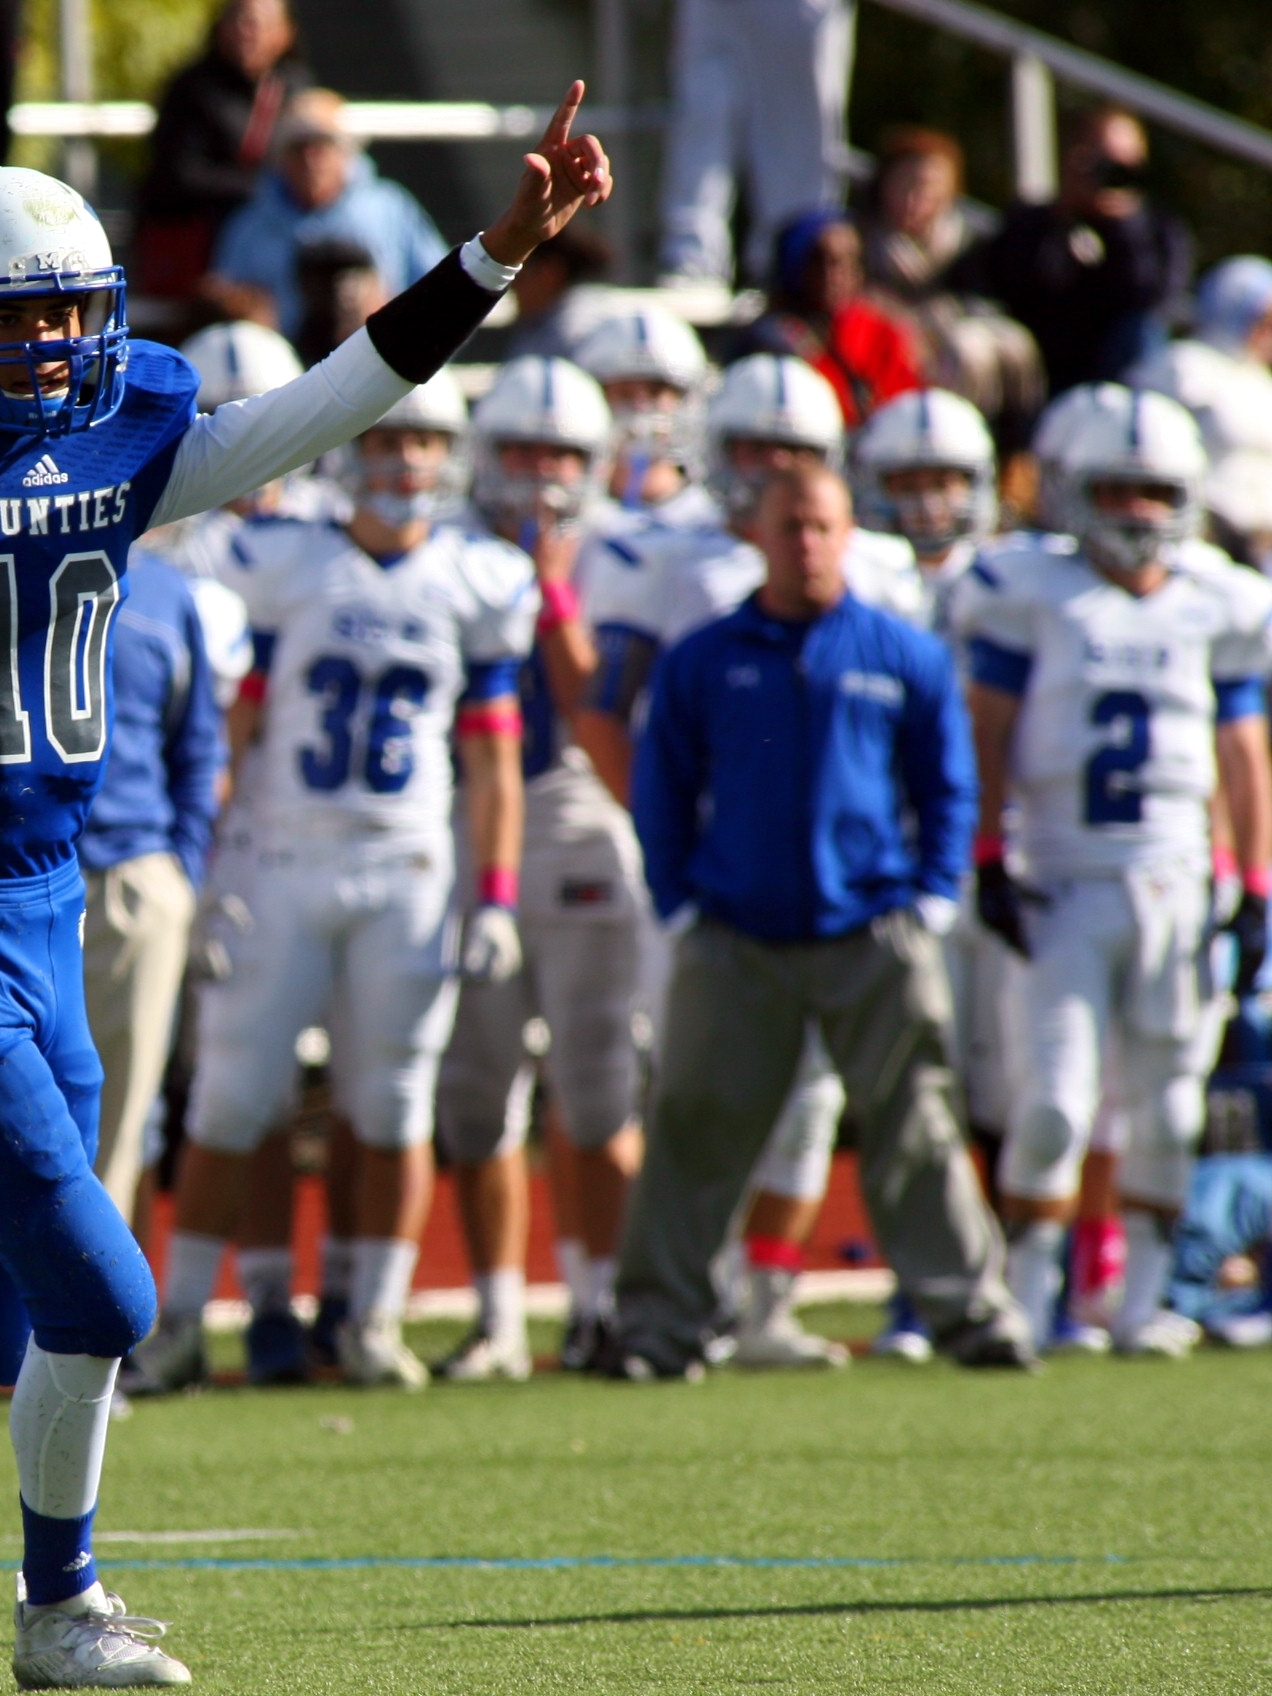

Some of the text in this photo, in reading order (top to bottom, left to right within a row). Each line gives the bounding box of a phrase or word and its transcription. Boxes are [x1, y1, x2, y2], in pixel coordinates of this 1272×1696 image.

[35, 252, 61, 271] M
[22, 472, 69, 487] adidas
[1086, 688, 1151, 827] 2
